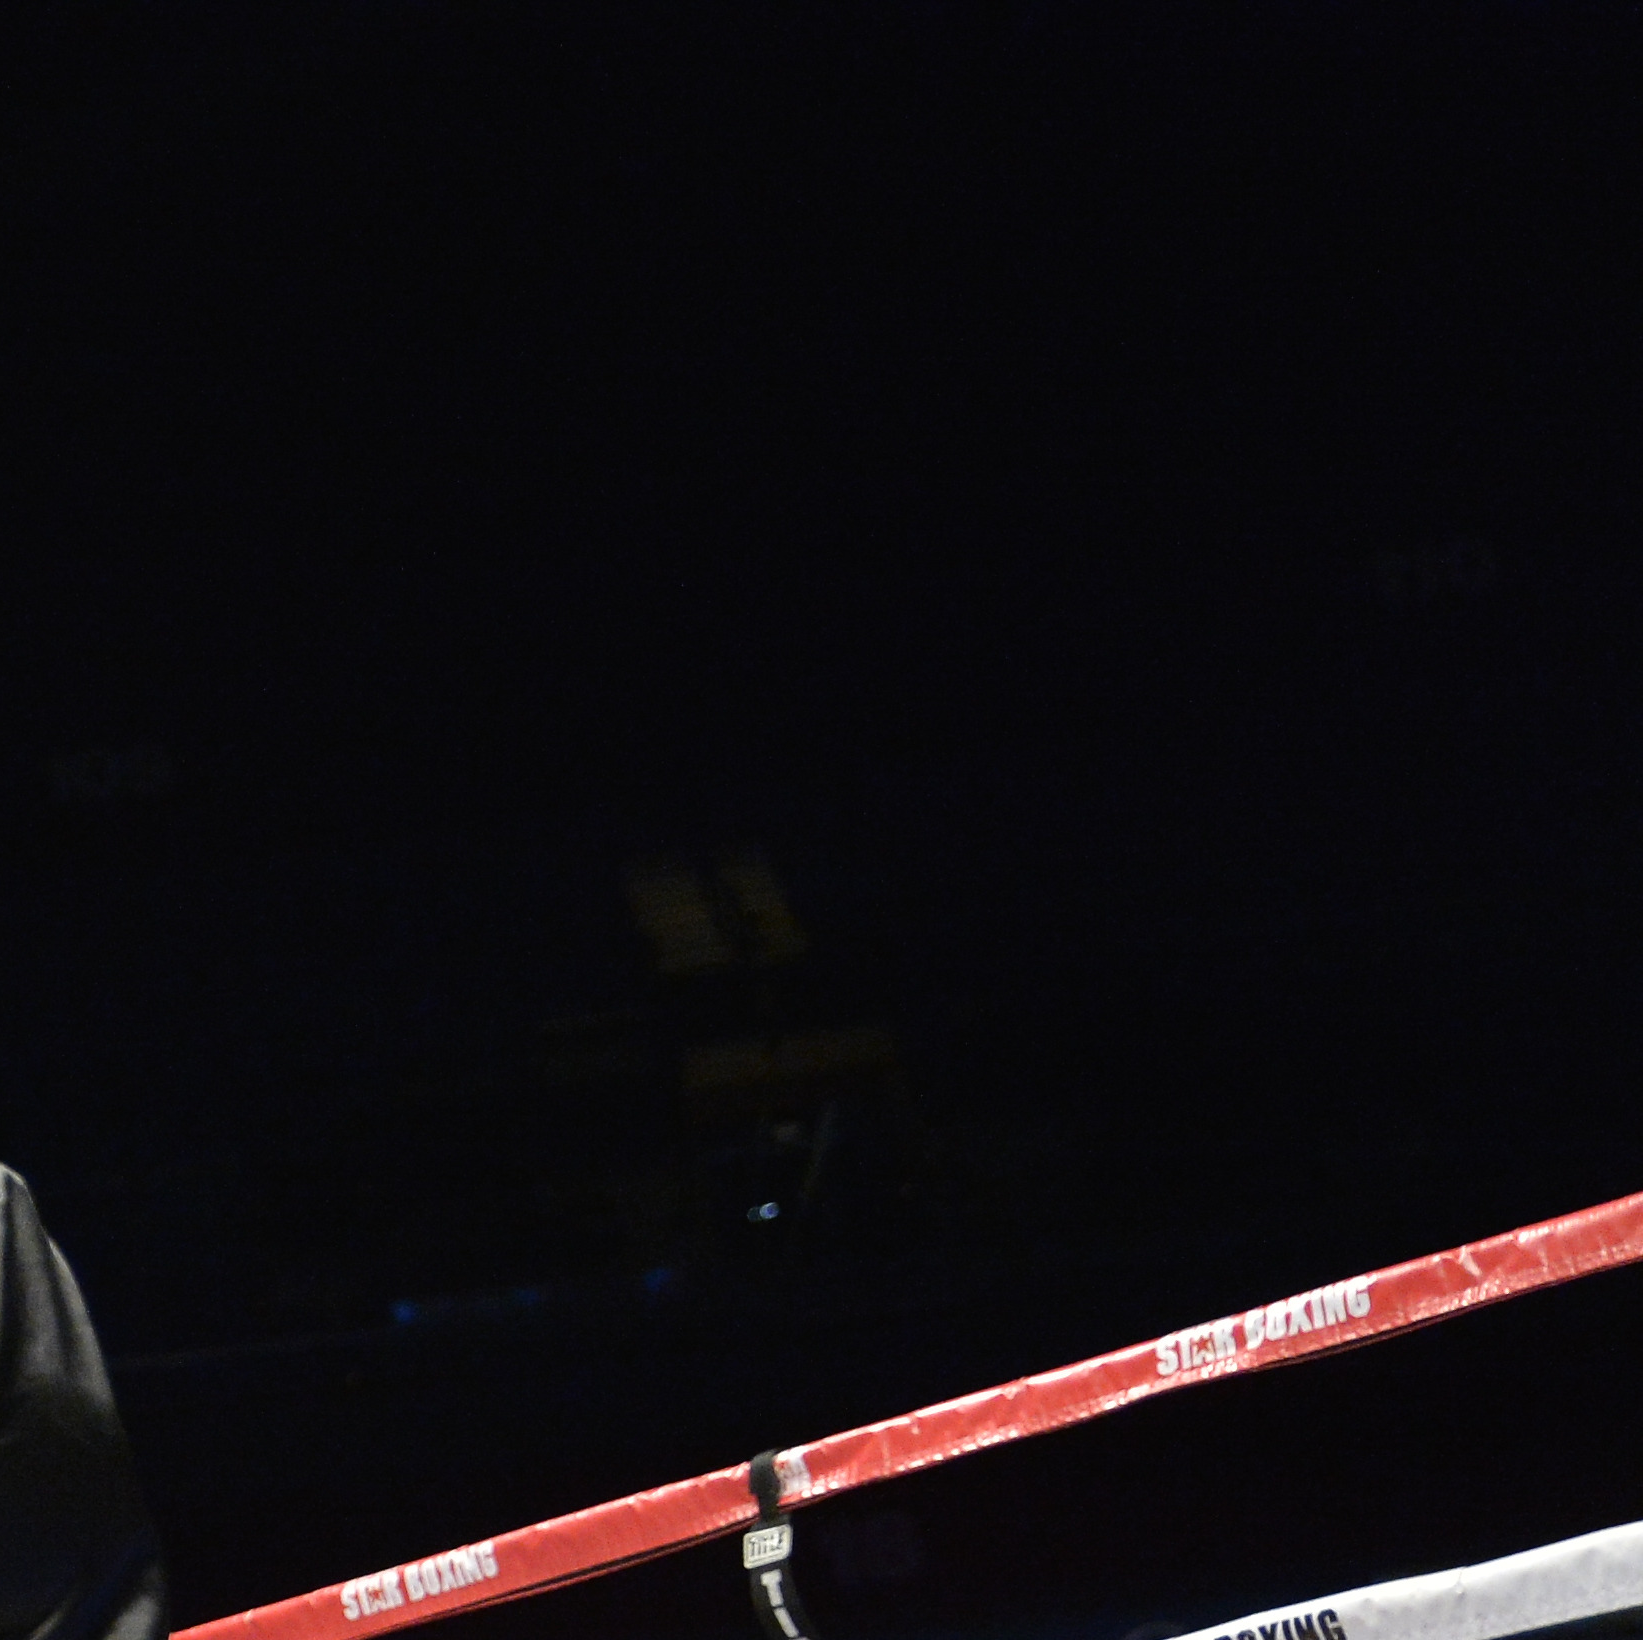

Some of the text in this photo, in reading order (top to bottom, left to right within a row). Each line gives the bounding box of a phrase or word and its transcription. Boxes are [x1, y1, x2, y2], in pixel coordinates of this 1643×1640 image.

[1155, 1275, 1376, 1376] STAR BOXING
[342, 1540, 499, 1620] STAR BOXING
